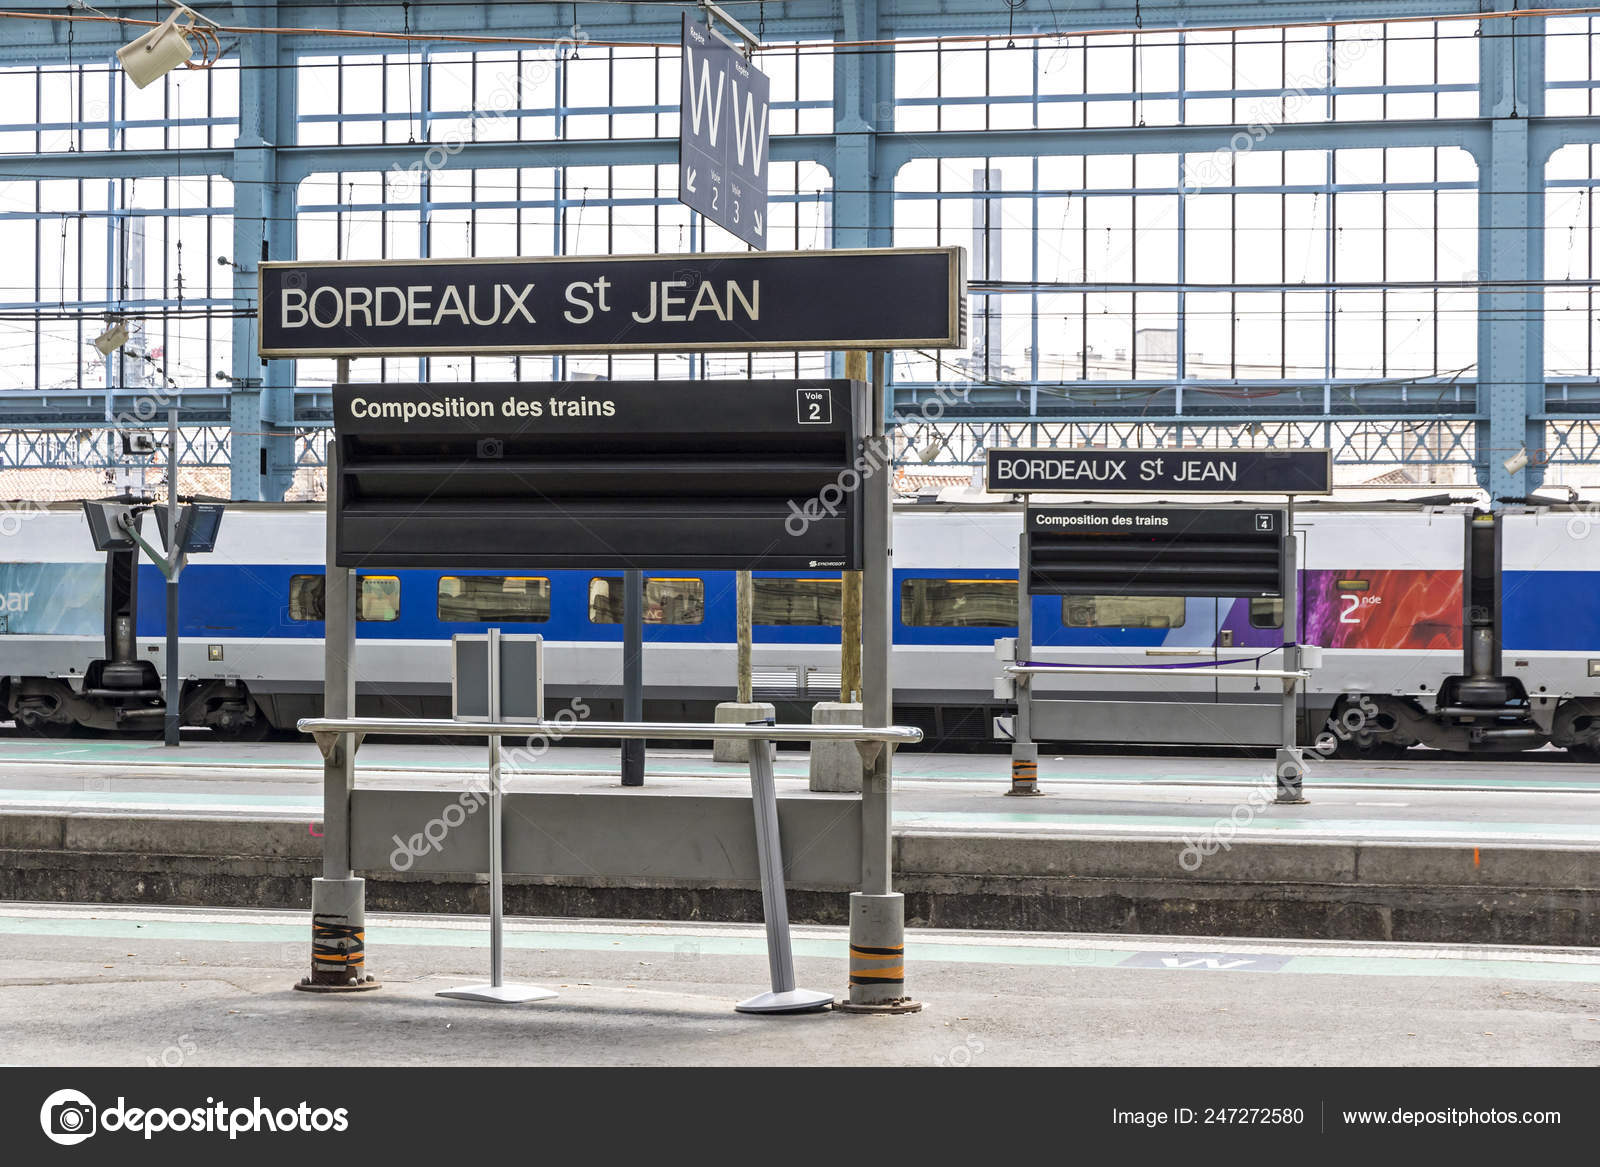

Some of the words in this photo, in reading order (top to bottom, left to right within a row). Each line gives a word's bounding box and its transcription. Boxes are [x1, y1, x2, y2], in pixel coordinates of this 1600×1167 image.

[687, 45, 725, 147] W
[732, 79, 768, 177] W
[712, 186, 719, 211] 2
[733, 200, 740, 224] 3
[281, 283, 537, 329] BORDEAUX
[563, 275, 611, 325] St
[631, 279, 760, 324] JEAN
[804, 392, 823, 400] Voie
[350, 396, 495, 423] Composition
[501, 396, 543, 417] des
[549, 395, 616, 417] trains
[808, 403, 821, 420] 2
[997, 458, 1127, 481] BORDEAUX
[1139, 457, 1164, 481] St
[1173, 461, 1238, 482] JEAN
[1035, 514, 1109, 528] Composition
[1111, 514, 1133, 526] des
[1135, 514, 1169, 526] trains
[1261, 520, 1268, 529] 4
